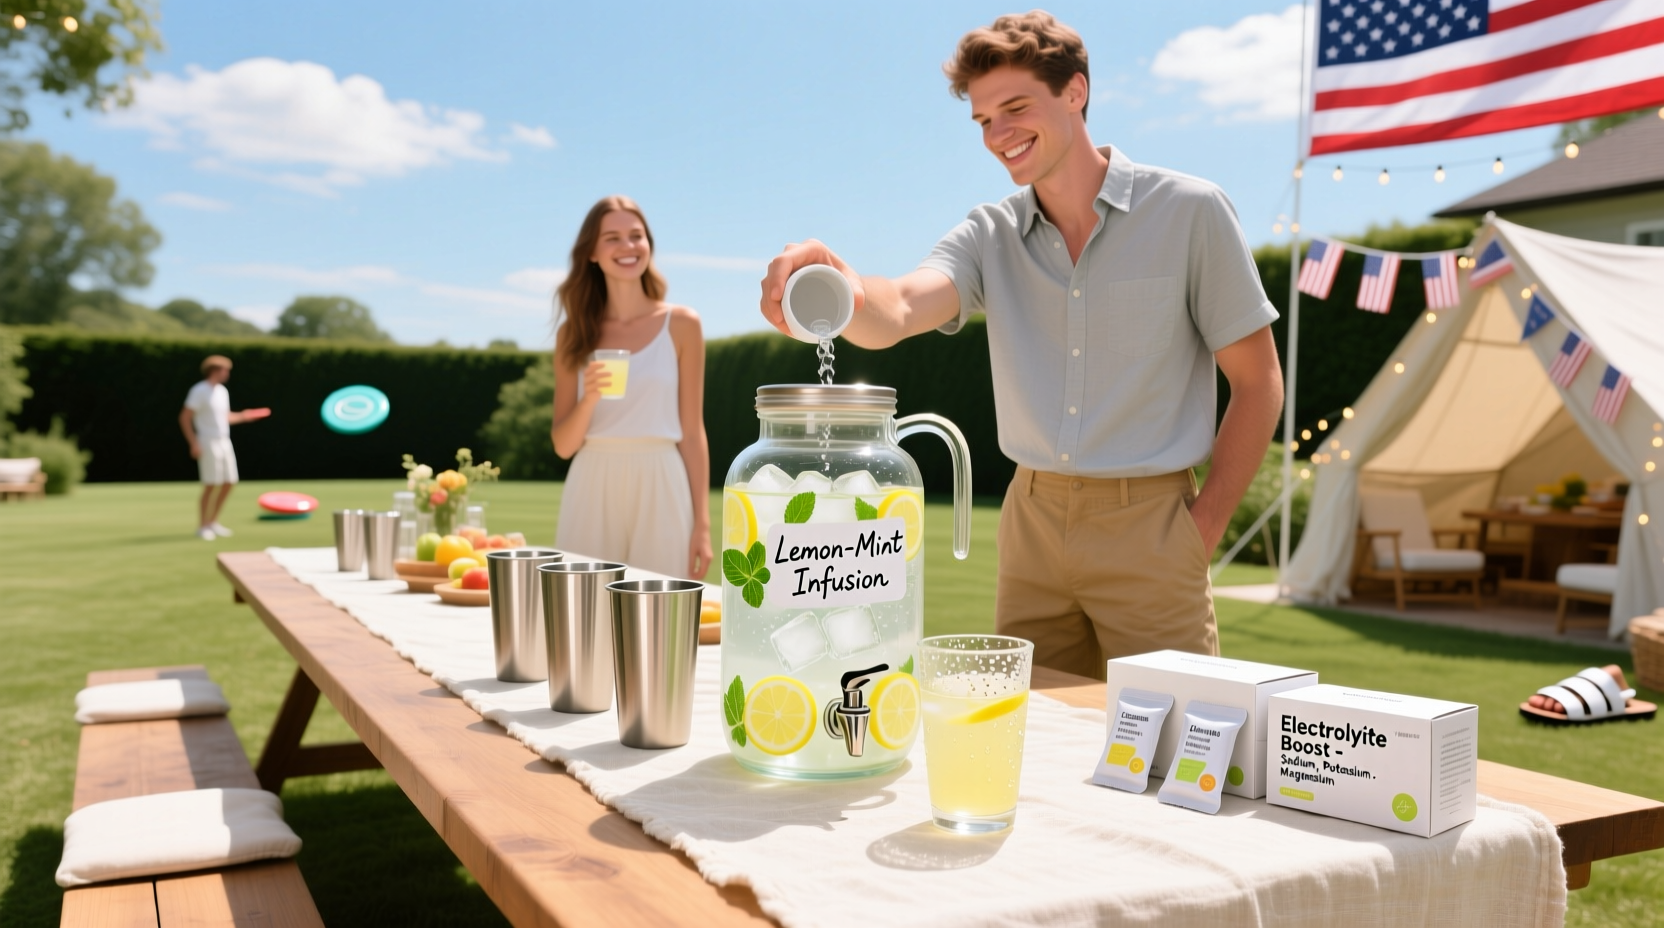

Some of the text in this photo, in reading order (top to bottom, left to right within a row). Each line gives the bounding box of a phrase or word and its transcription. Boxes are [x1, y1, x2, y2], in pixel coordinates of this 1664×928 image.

[775, 529, 903, 564] Lemon-Mint
[792, 565, 889, 600] Infusion
[1281, 734, 1330, 757] Boost
